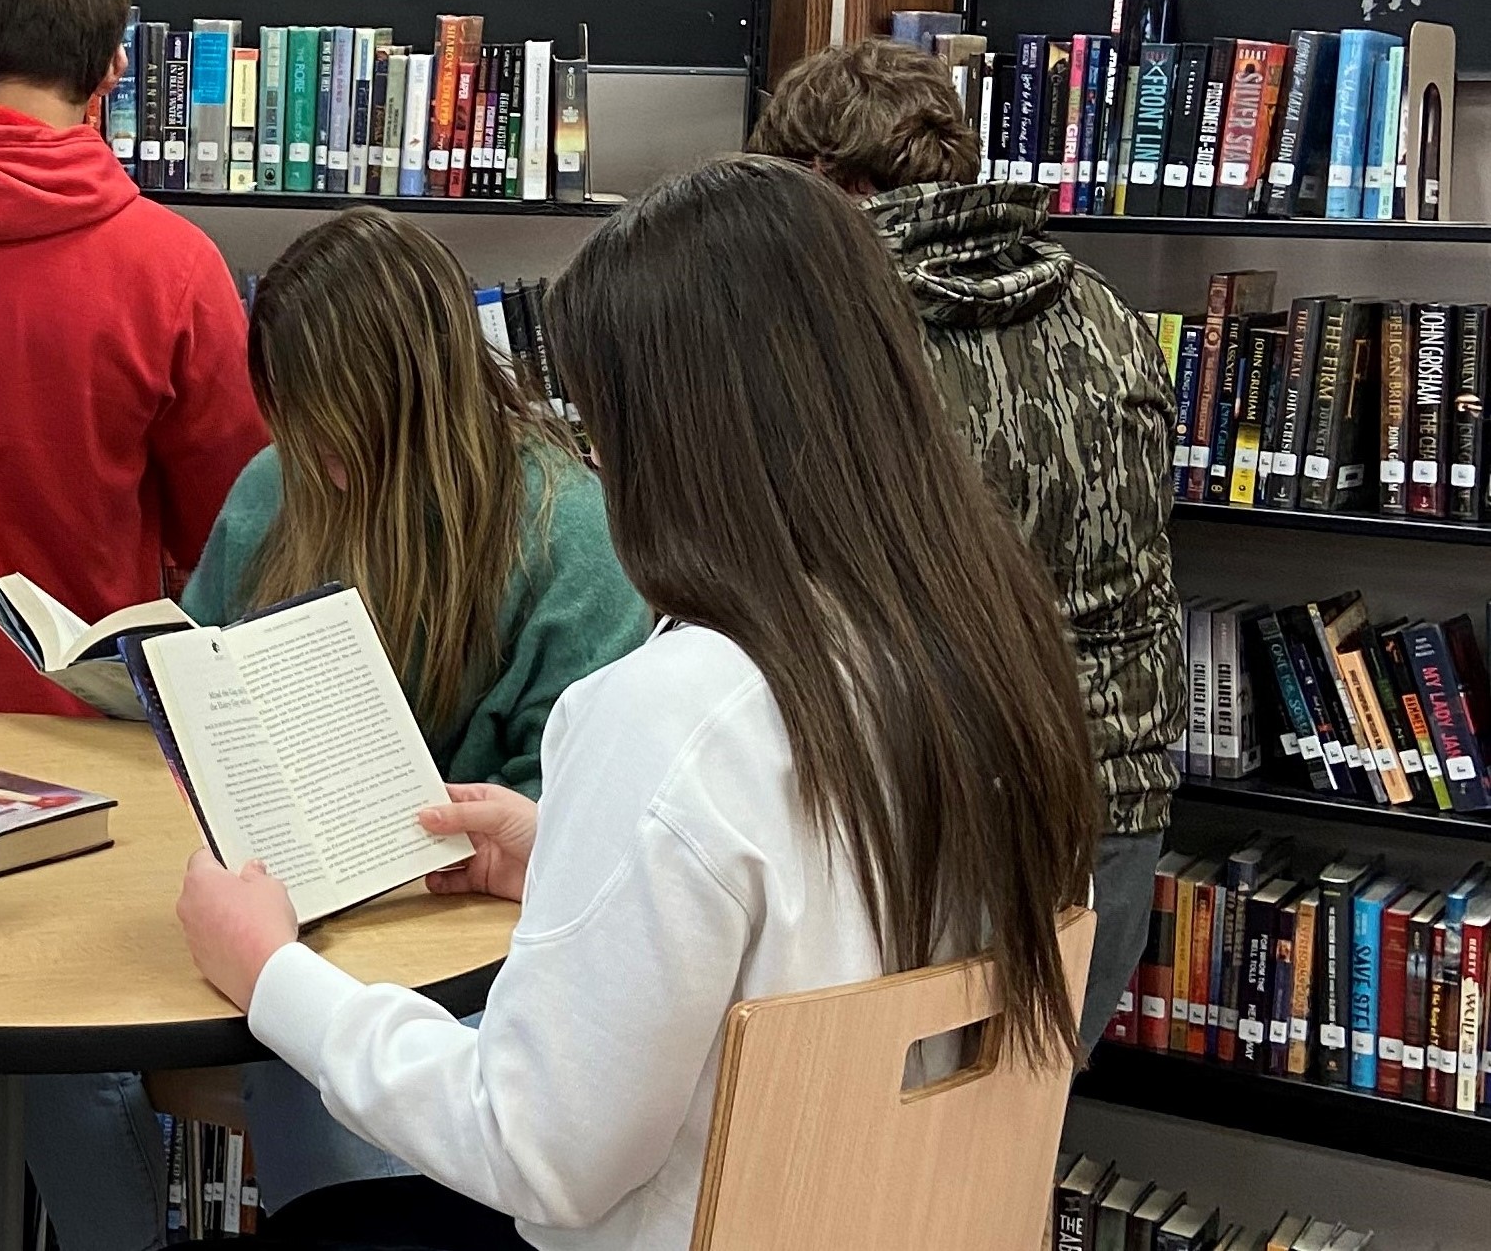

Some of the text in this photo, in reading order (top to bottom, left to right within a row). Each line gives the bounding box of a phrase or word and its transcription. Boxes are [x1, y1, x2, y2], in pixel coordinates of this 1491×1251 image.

[444, 24, 457, 69] SHARON
[169, 75, 177, 95] BLUE
[176, 71, 184, 102] YELLOW
[293, 63, 305, 93] ROBE
[1105, 49, 1117, 106] STAR WARS
[1228, 72, 1263, 129] SILVER
[1277, 36, 1311, 161] LOOKING ALASKA JOHN
[168, 97, 176, 126] WATER
[175, 103, 184, 126] RAFT
[439, 84, 452, 126] DRAPER
[1138, 75, 1168, 130] FRONT
[1199, 82, 1223, 133] PRISONER
[1064, 124, 1079, 162] GIRL
[1464, 313, 1477, 329] THE
[1182, 370, 1193, 391] KING
[1246, 337, 1265, 420] JOHN GRISHAM
[1285, 308, 1309, 419] THE APPEAL JOHN
[1318, 313, 1344, 435] THE FIRM JOHN
[1388, 315, 1403, 450] PELICAN BRIEF JOHN
[1416, 310, 1446, 434] JOHN GRISHAM THE
[1462, 334, 1477, 391] TESTAMENT
[1423, 666, 1451, 727] MY LADY
[1248, 939, 1259, 984] BELL TOLLS
[1352, 944, 1372, 988] SAVE
